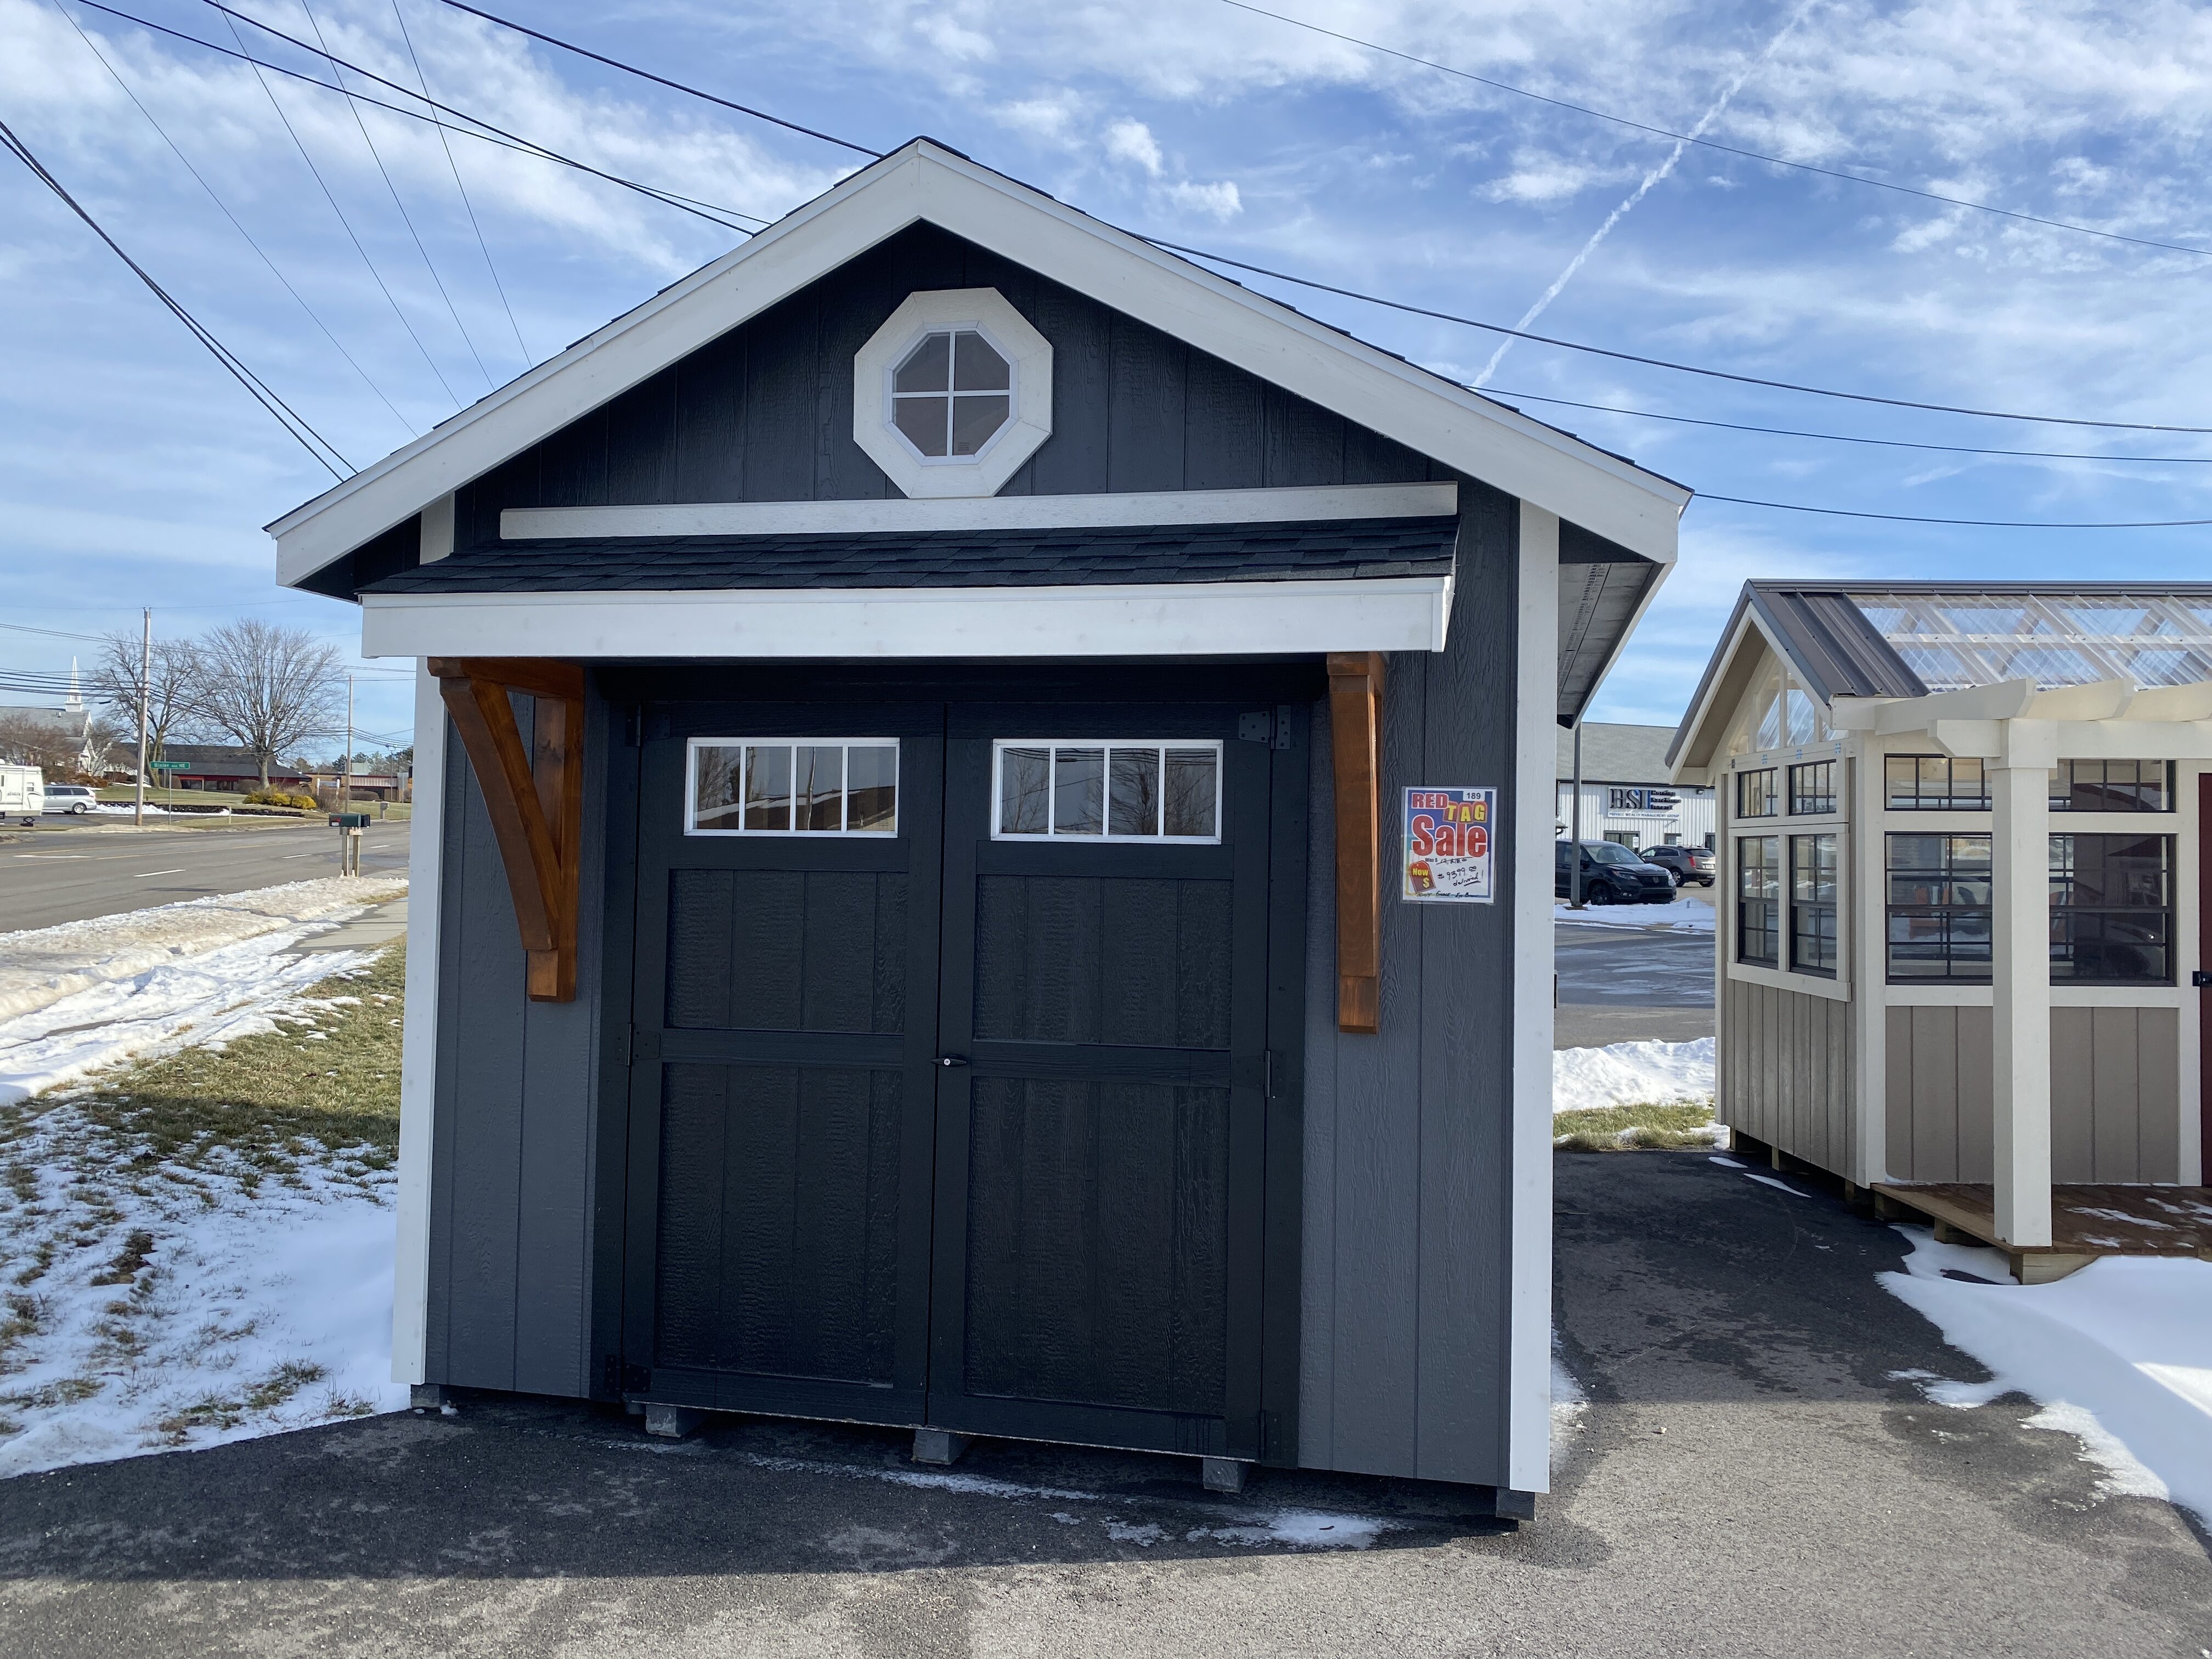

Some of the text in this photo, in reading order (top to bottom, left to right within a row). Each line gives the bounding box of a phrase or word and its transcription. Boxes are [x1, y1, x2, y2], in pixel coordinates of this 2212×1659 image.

[1412, 793, 1485, 822] RED TAG
[1412, 814, 1487, 857] Sale
[1423, 877, 1430, 889] $
